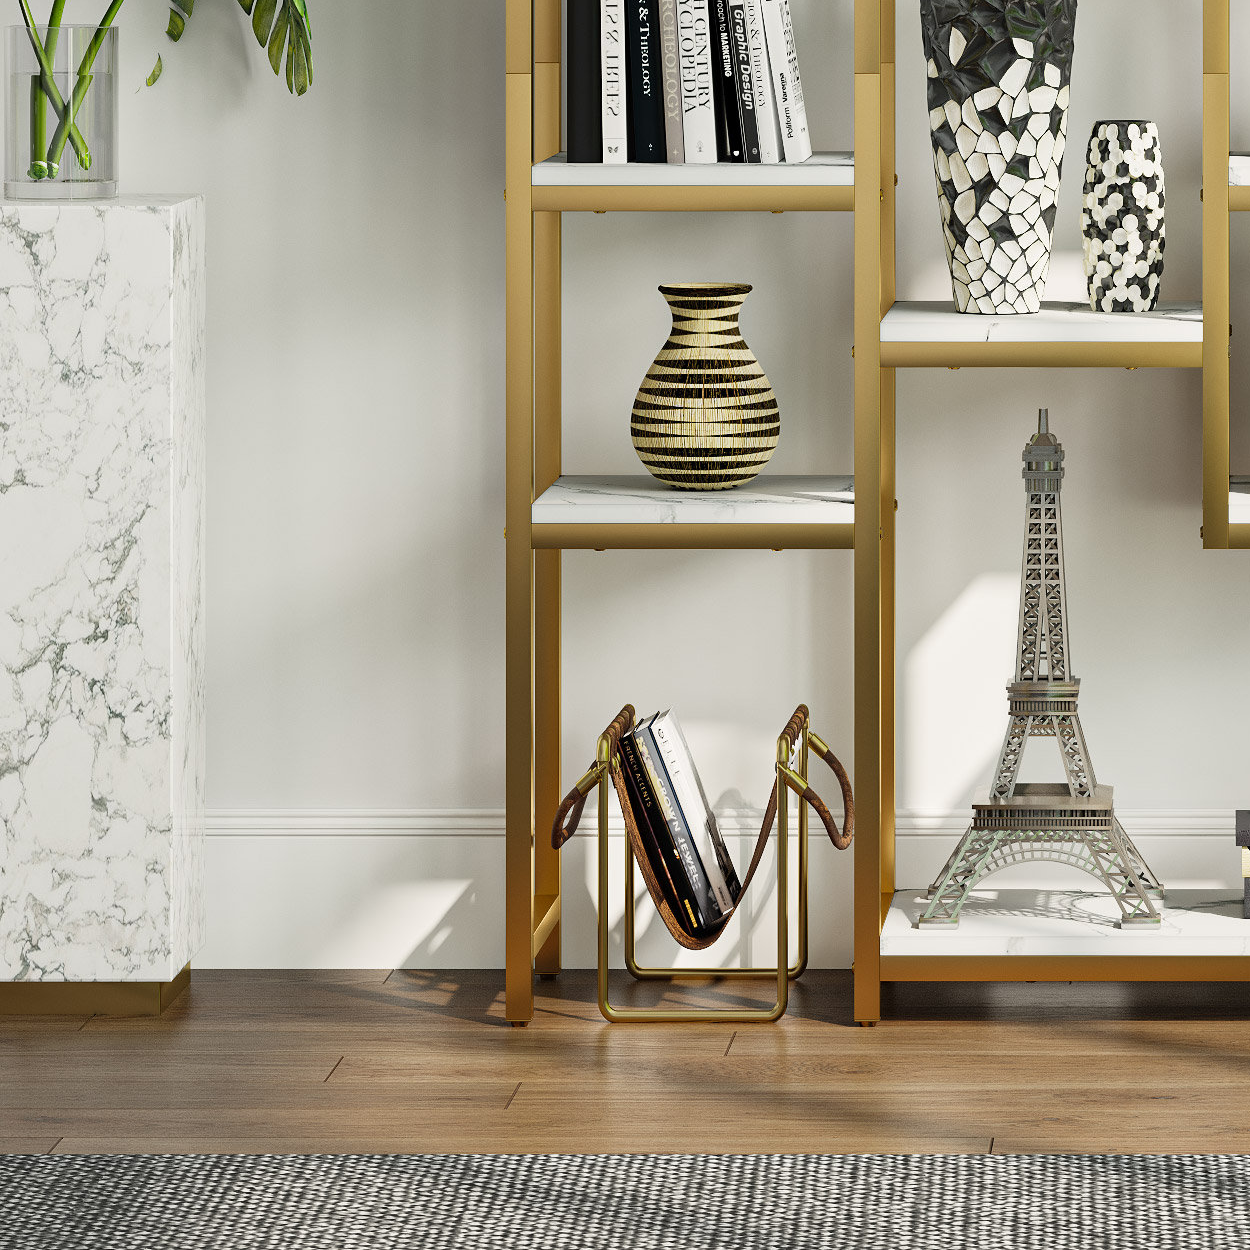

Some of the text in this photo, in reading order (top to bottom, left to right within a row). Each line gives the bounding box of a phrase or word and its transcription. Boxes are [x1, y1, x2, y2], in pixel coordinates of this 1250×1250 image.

[638, 6, 650, 22] &
[720, 24, 727, 32] to
[734, 9, 749, 61] Graphic
[751, 29, 760, 42] &
[694, 18, 711, 110] CENTURY
[720, 32, 732, 78] MARKETING
[741, 64, 754, 110] Design
[785, 107, 794, 138] Poliform
